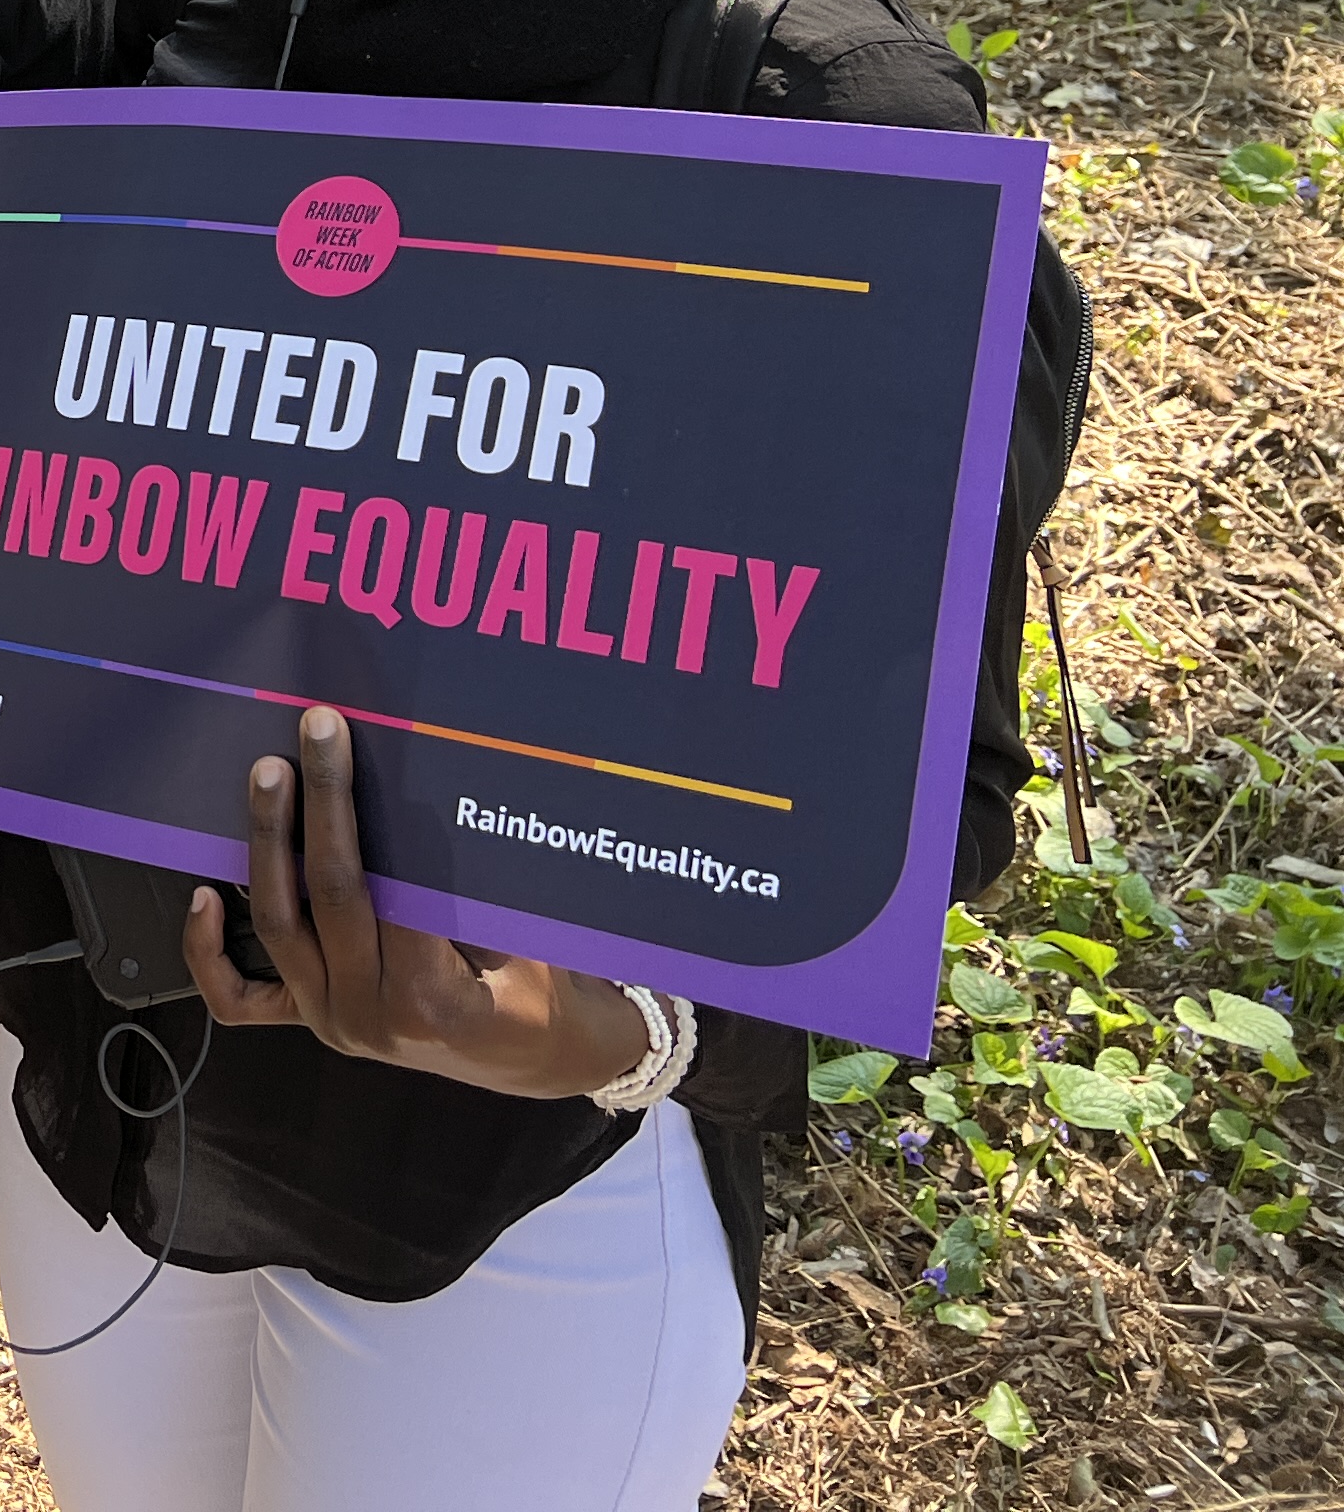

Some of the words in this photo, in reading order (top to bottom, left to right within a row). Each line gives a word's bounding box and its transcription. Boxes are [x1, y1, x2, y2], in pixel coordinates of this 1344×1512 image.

[304, 201, 382, 224] RAINBOW
[316, 225, 362, 248] WEEK
[292, 248, 316, 268] OF
[314, 250, 374, 273] ACTION
[54, 314, 378, 451] UNITED
[396, 349, 605, 487] FOR
[280, 486, 821, 689] EQUALITY
[456, 795, 781, 899] RainbowEquality.ca
